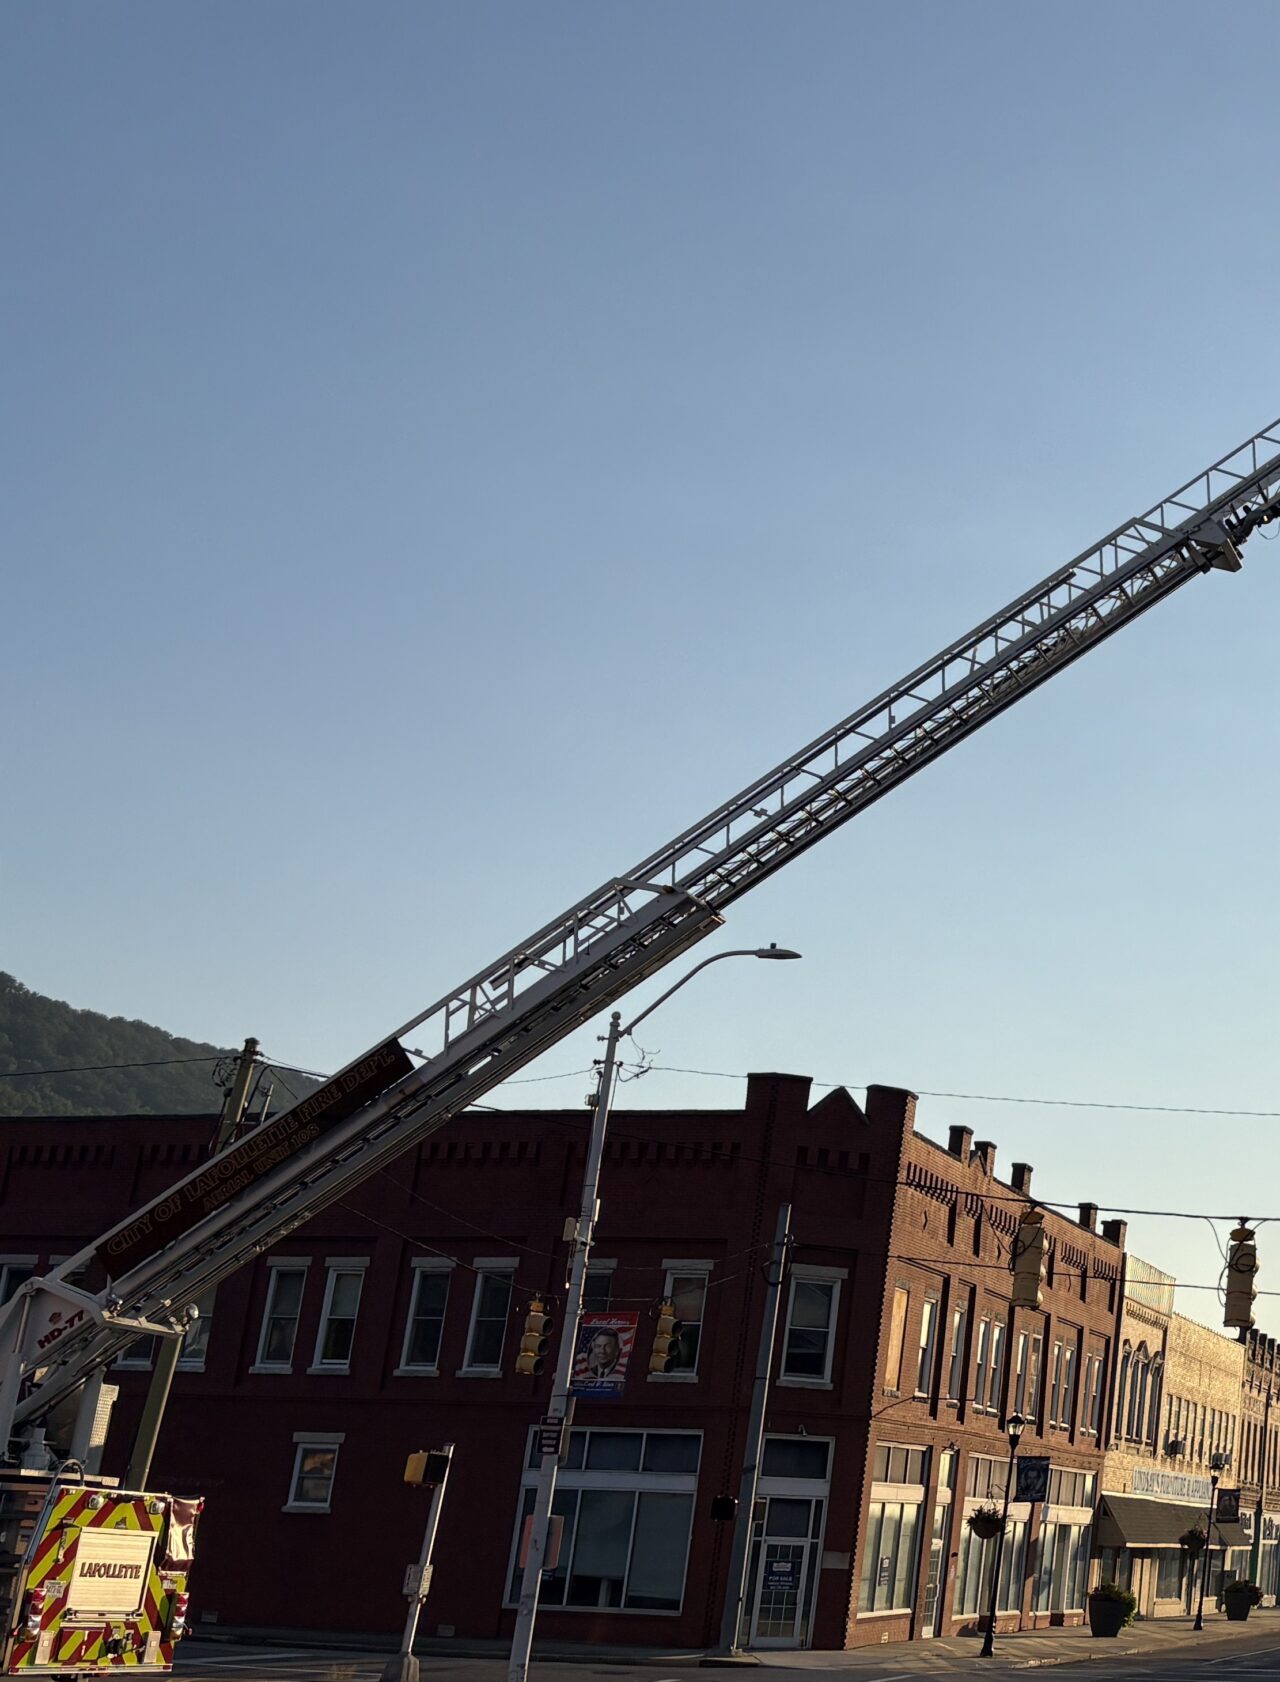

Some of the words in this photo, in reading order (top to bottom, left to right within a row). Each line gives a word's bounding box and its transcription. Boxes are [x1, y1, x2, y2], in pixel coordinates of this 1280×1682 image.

[107, 1212, 154, 1256] CITY
[154, 1194, 184, 1224] OF
[184, 1115, 299, 1202] LAFOLLETTE
[300, 1083, 342, 1123] FIRE
[203, 1169, 255, 1213] AERIAL
[256, 1143, 293, 1176] UNIT
[291, 1122, 321, 1151] 108
[37, 1309, 84, 1349] HD-77
[79, 1562, 142, 1580] LAFOLLETTE
